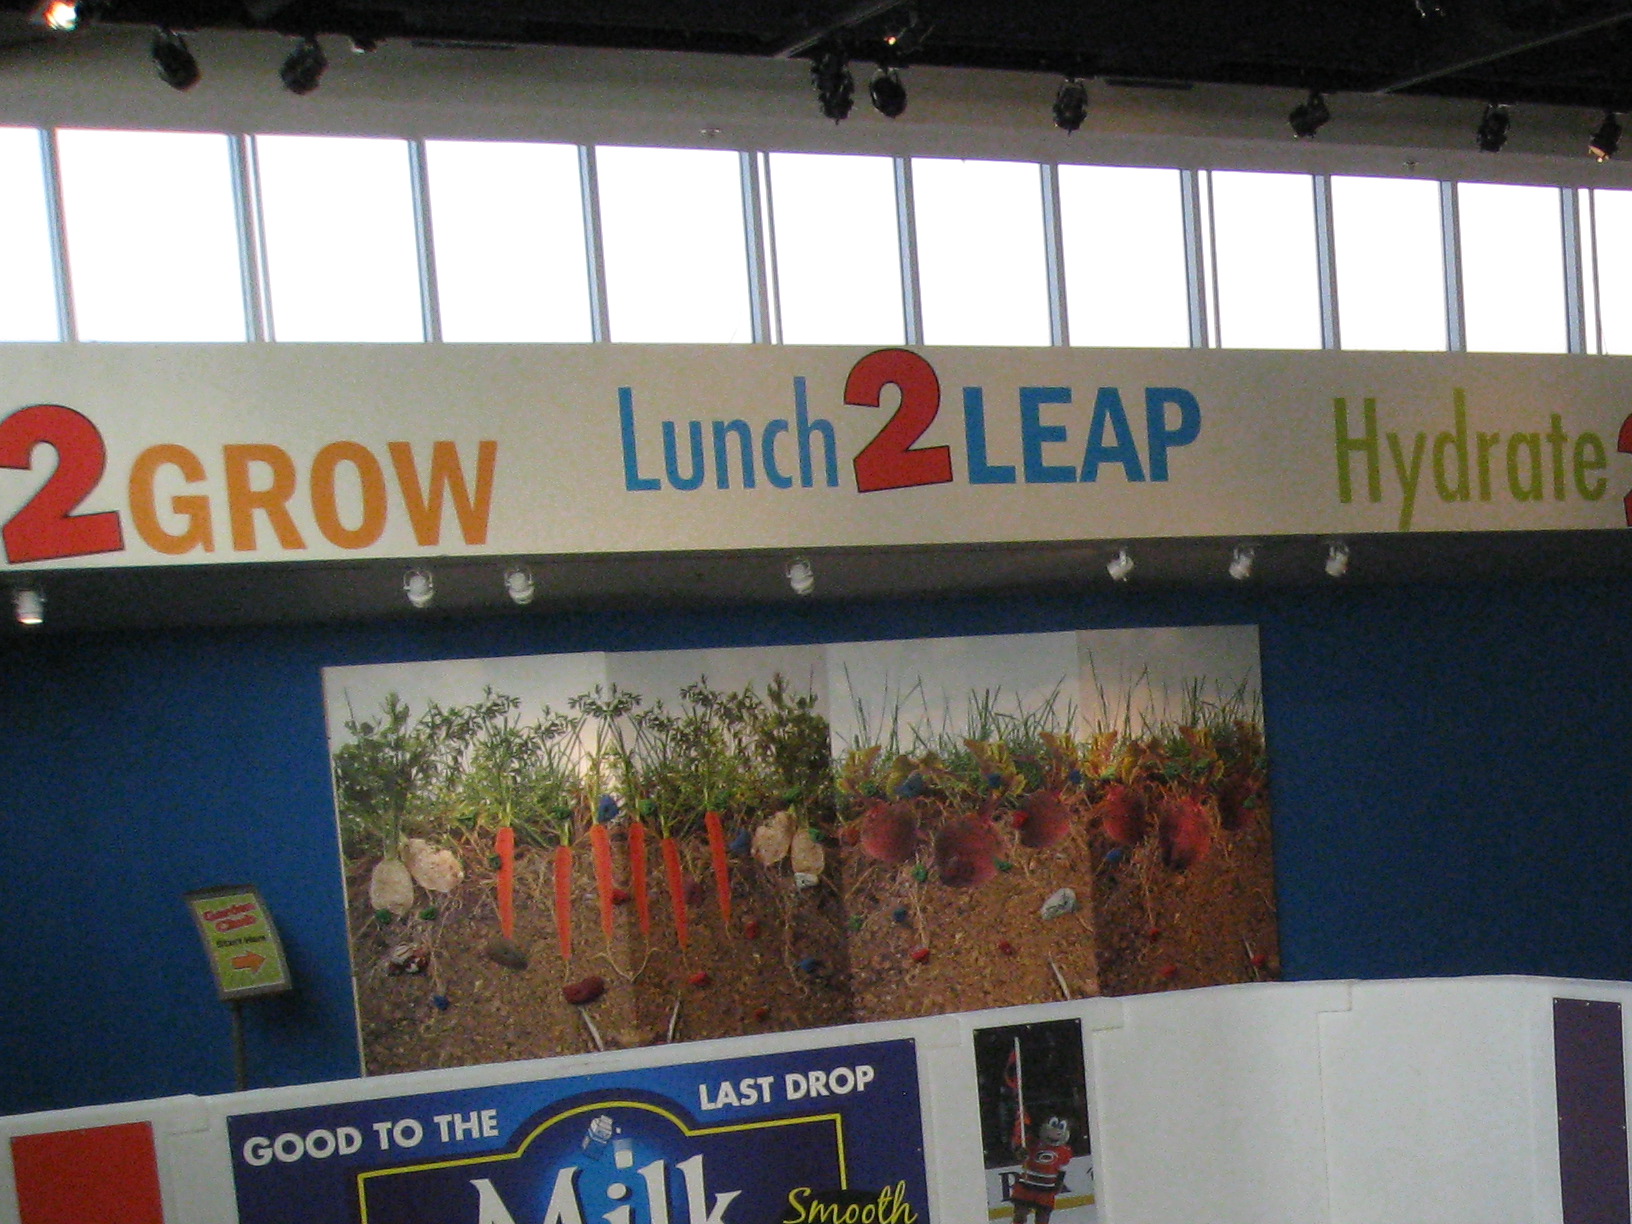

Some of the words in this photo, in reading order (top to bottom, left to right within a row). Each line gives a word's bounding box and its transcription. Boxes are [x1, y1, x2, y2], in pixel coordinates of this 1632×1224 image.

[698, 1074, 773, 1112] LAST
[785, 1063, 876, 1100] DROP
[242, 1126, 363, 1167] GOOD
[372, 1117, 424, 1152] TO
[437, 1108, 499, 1143] THE
